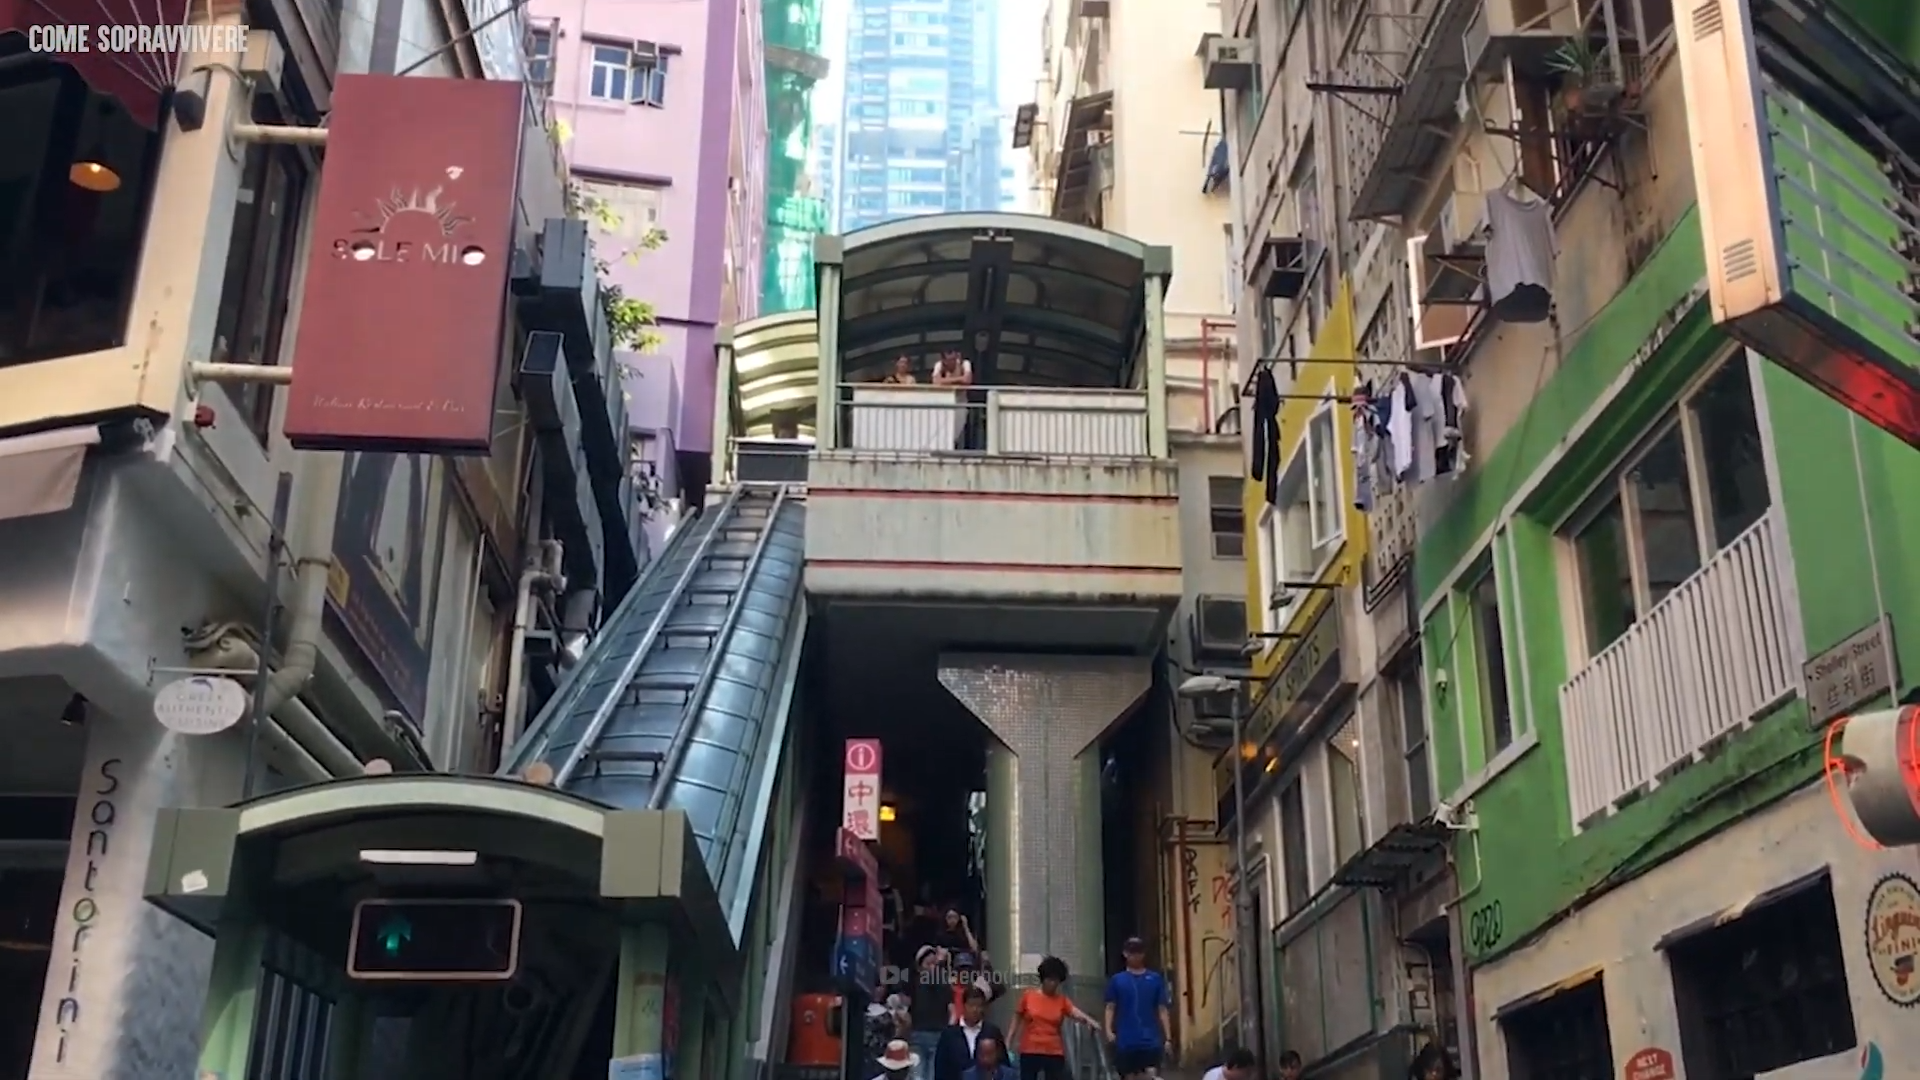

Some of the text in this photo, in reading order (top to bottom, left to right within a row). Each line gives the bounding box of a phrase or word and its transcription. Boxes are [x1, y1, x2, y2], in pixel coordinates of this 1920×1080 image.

[331, 238, 486, 266] SOLE MIO
[1814, 631, 1881, 682] Shelley Street
[55, 757, 122, 1064] Santorini
[1636, 1053, 1658, 1069] NEXT
